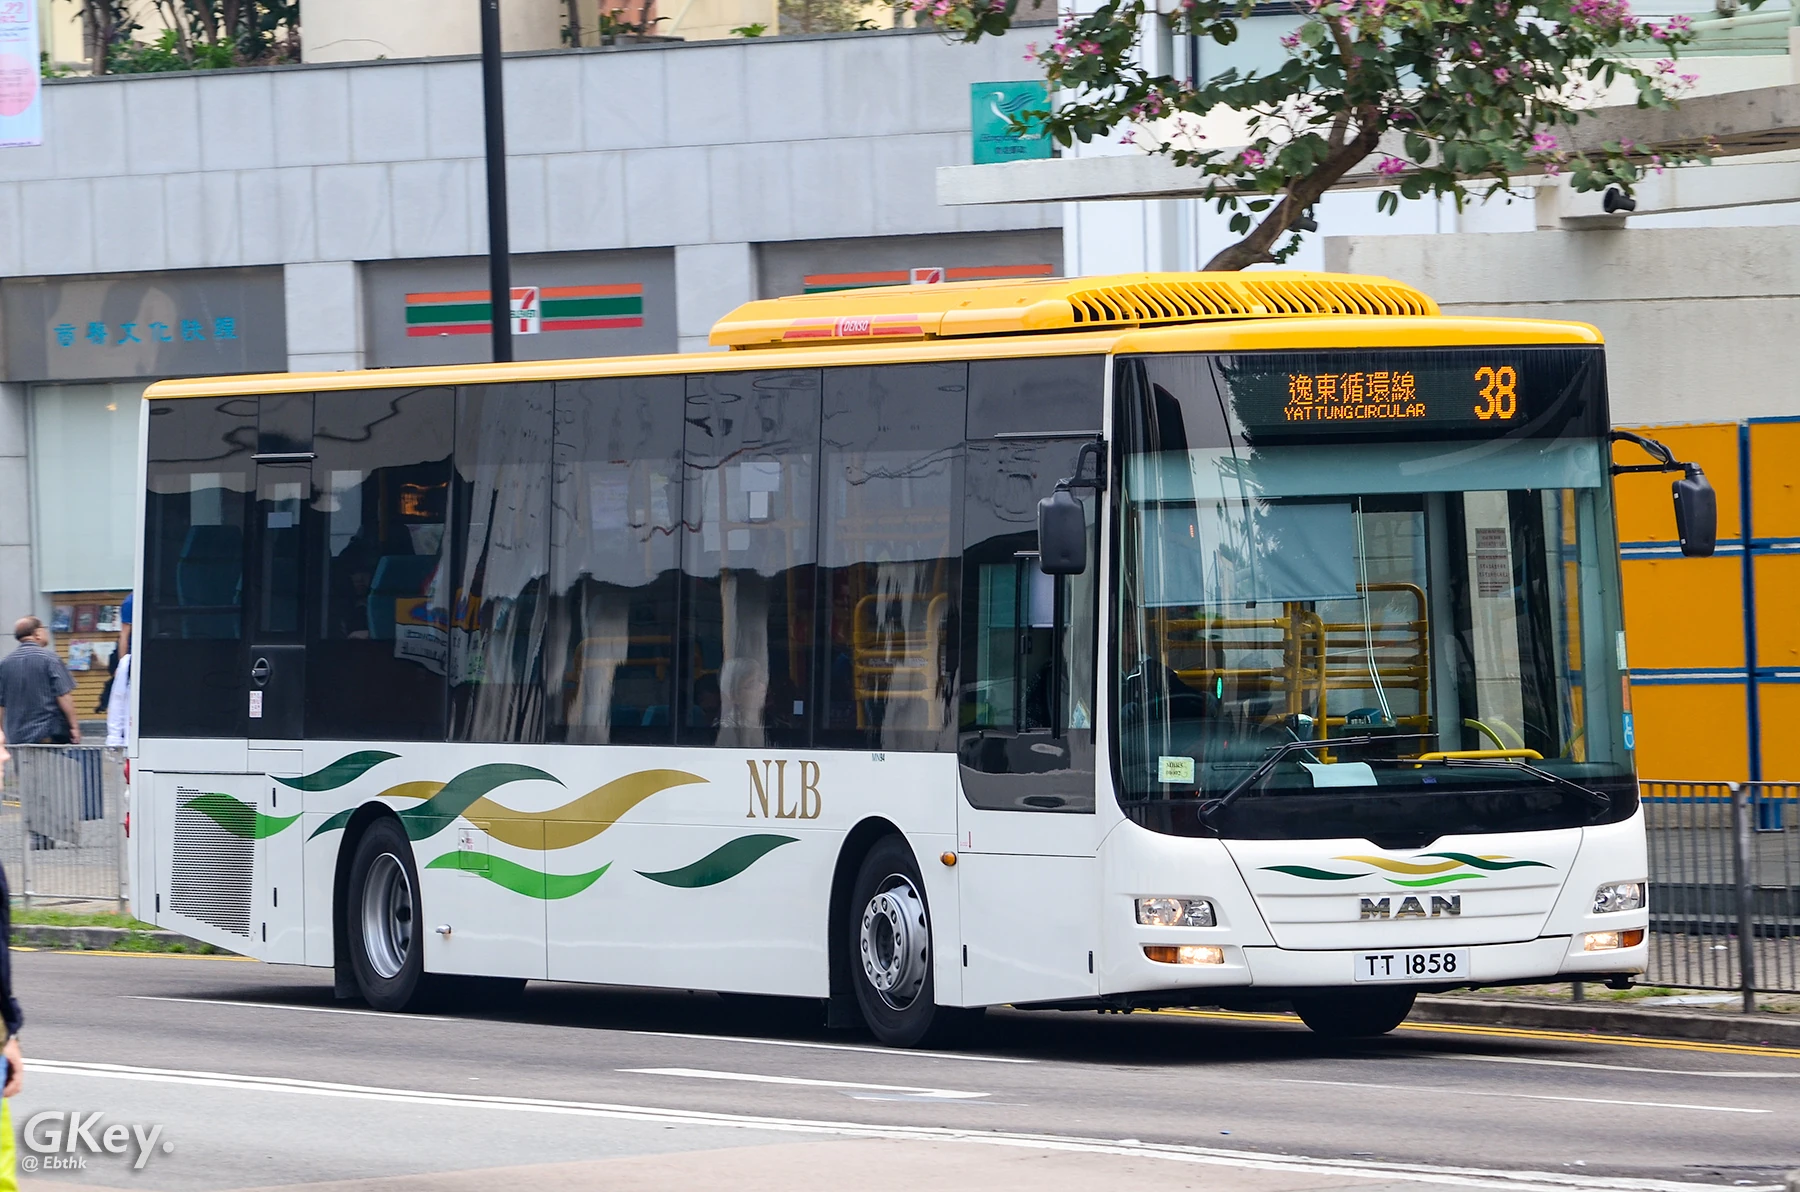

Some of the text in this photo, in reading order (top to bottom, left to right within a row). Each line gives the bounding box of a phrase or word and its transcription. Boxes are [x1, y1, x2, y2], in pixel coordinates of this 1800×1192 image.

[843, 320, 869, 332] DENSO
[1288, 371, 1416, 405] 逸東循環線
[1474, 366, 1517, 420] 38
[1284, 403, 1426, 421] YAT TUNG CIRCULAR
[746, 759, 822, 820] NLB
[1359, 894, 1461, 920] MAN
[1365, 953, 1457, 976] TT 1858
